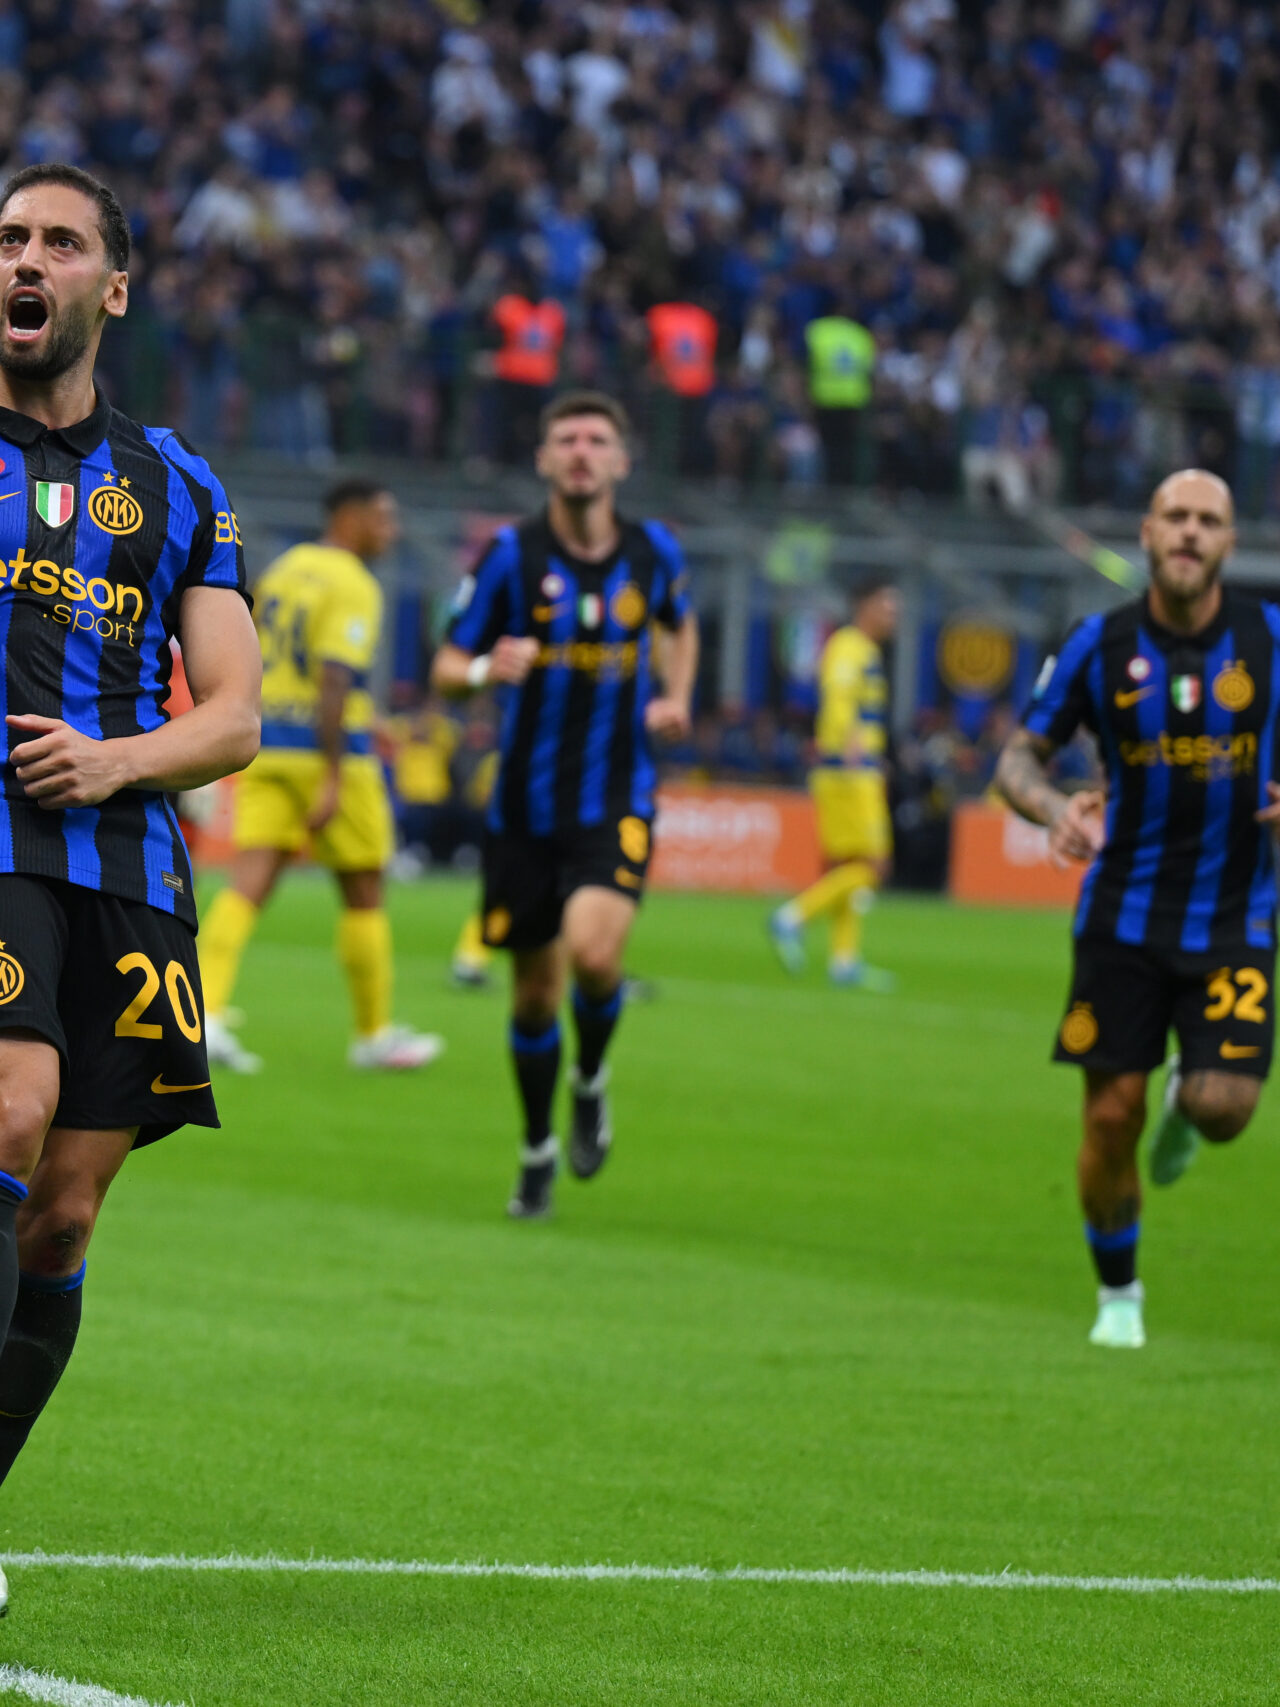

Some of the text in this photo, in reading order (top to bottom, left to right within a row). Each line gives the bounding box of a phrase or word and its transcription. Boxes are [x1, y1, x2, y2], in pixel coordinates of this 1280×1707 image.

[43, 604, 135, 647] .sport
[115, 952, 201, 1043] 20
[1204, 967, 1267, 1023] 32
